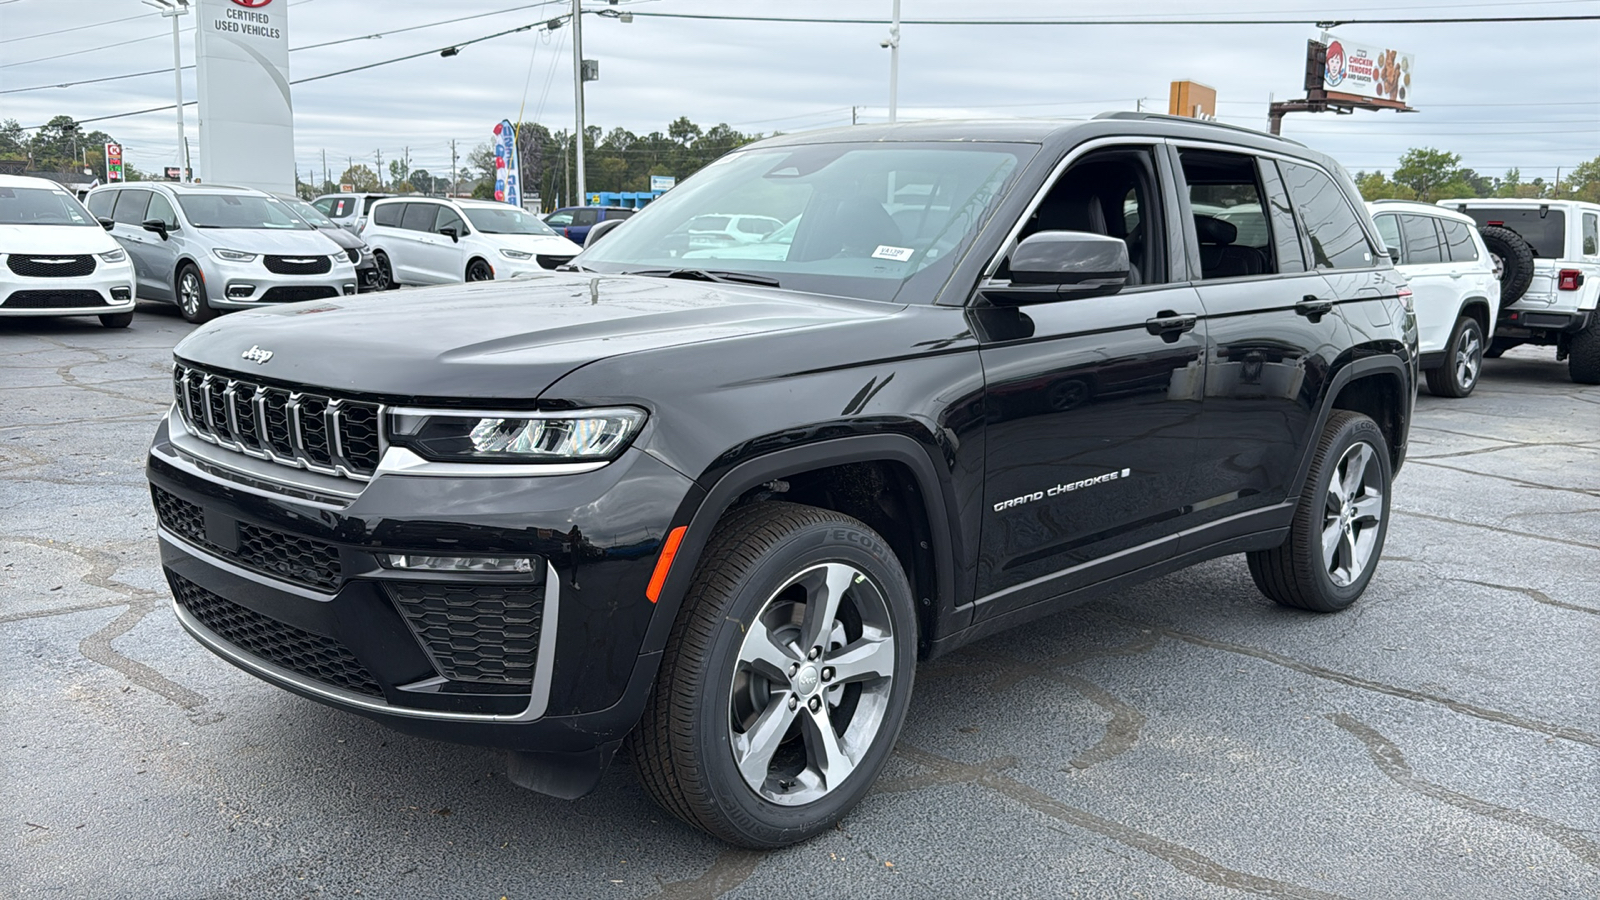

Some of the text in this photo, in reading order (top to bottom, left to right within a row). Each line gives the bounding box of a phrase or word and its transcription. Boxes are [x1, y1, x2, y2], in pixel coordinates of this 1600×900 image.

[226, 8, 269, 24] CERTIFIED
[214, 19, 280, 39] USED VEHICLES
[1348, 56, 1373, 67] CHICKEN
[1348, 65, 1372, 76] TENDERS
[241, 344, 274, 365] Jeep
[993, 471, 1119, 512] GRAND CHEROKEE
